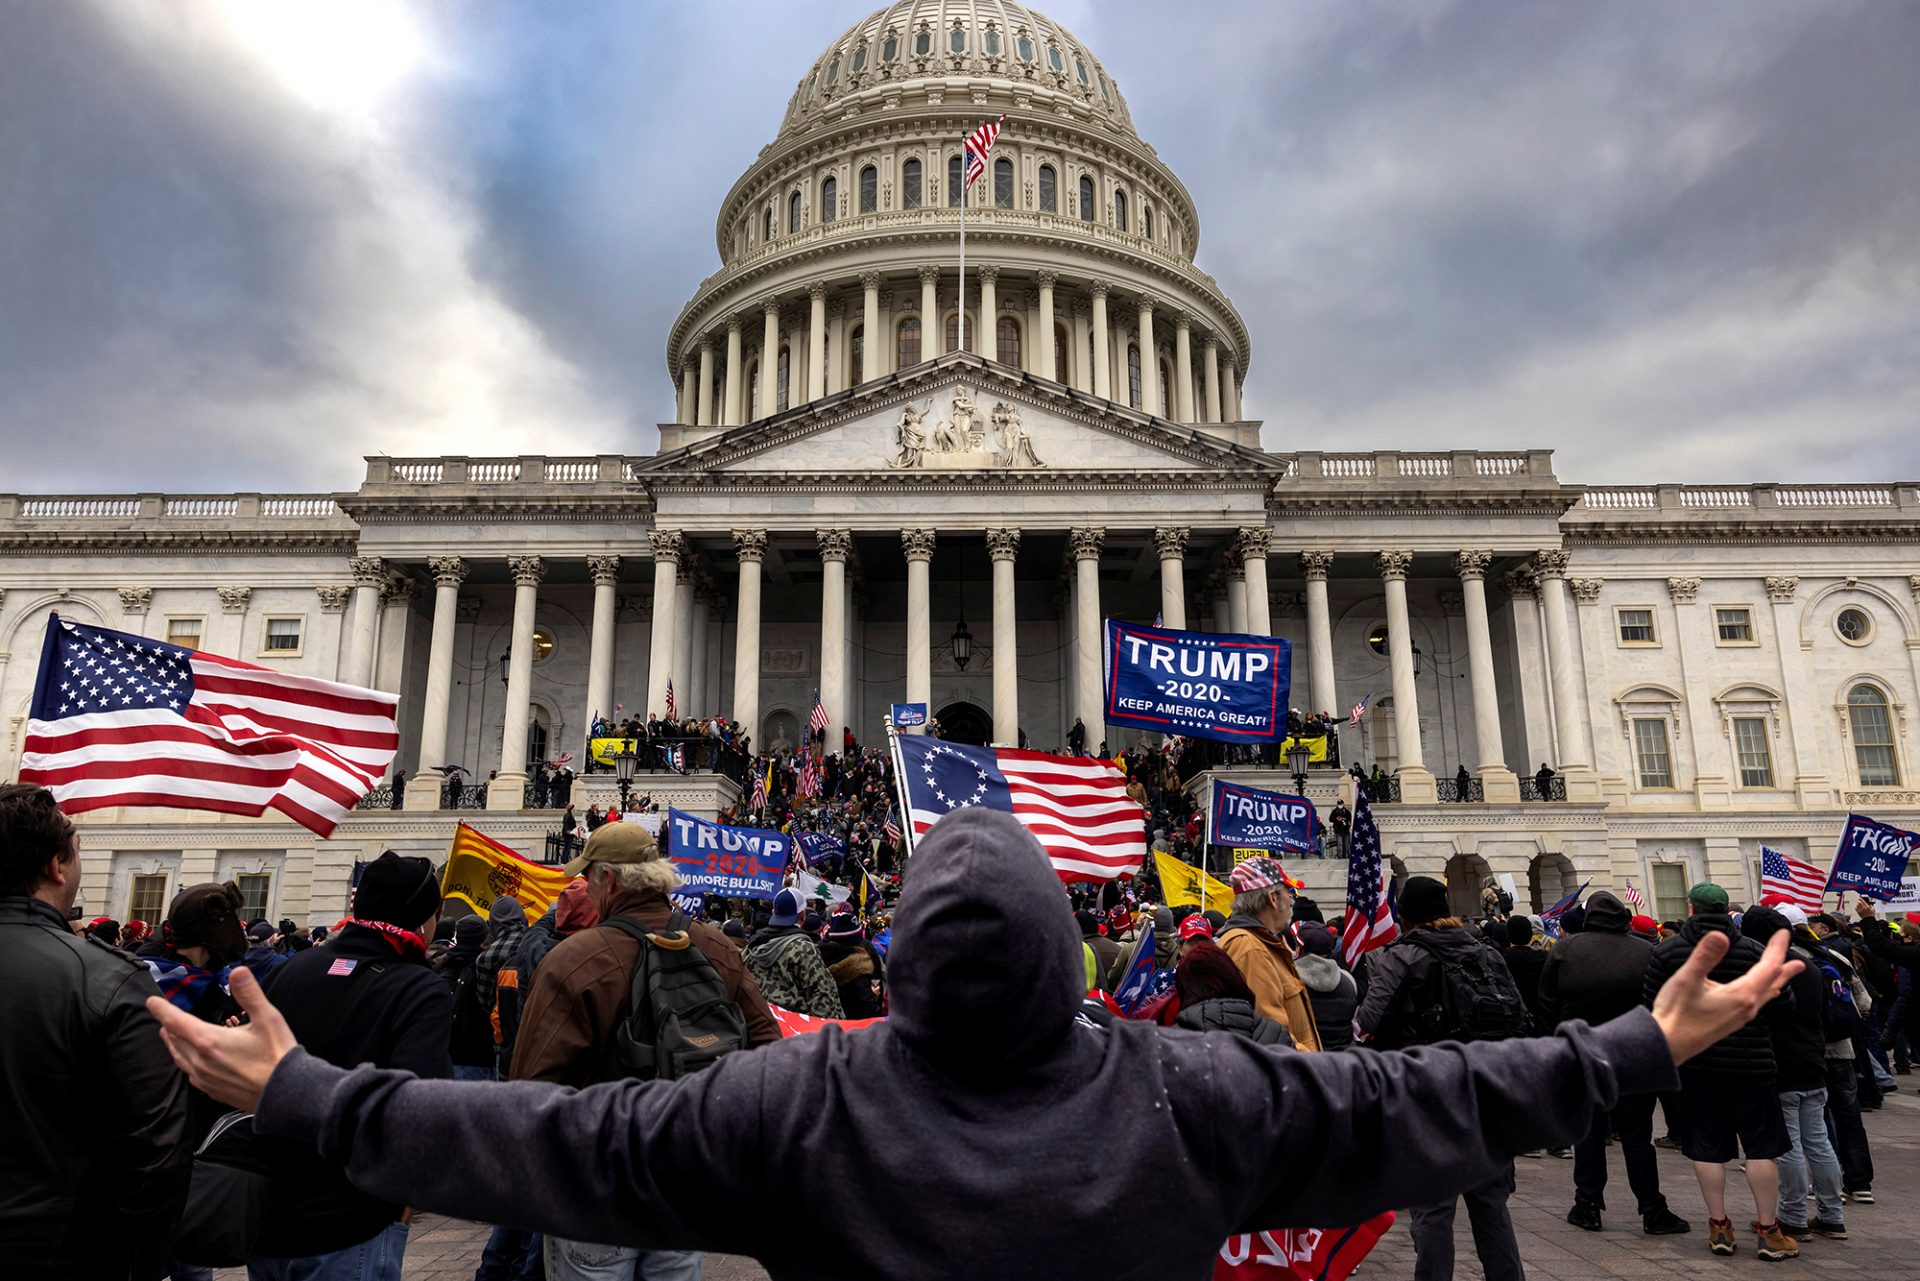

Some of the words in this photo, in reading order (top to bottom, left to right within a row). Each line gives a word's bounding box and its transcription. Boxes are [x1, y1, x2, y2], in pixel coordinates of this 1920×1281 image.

[1125, 635, 1269, 682] TRUMP
[1118, 697, 1153, 711] KEEP
[1156, 700, 1216, 720] AMERICA
[1219, 711, 1267, 726] GREAT!
[1226, 793, 1307, 824] TRUMP
[675, 818, 783, 856] TRUMP
[1220, 834, 1242, 842] KEEP
[1244, 835, 1283, 843] AMERICA
[705, 853, 761, 876] 2020
[1836, 871, 1862, 882] KEEP
[692, 875, 729, 888] MORE
